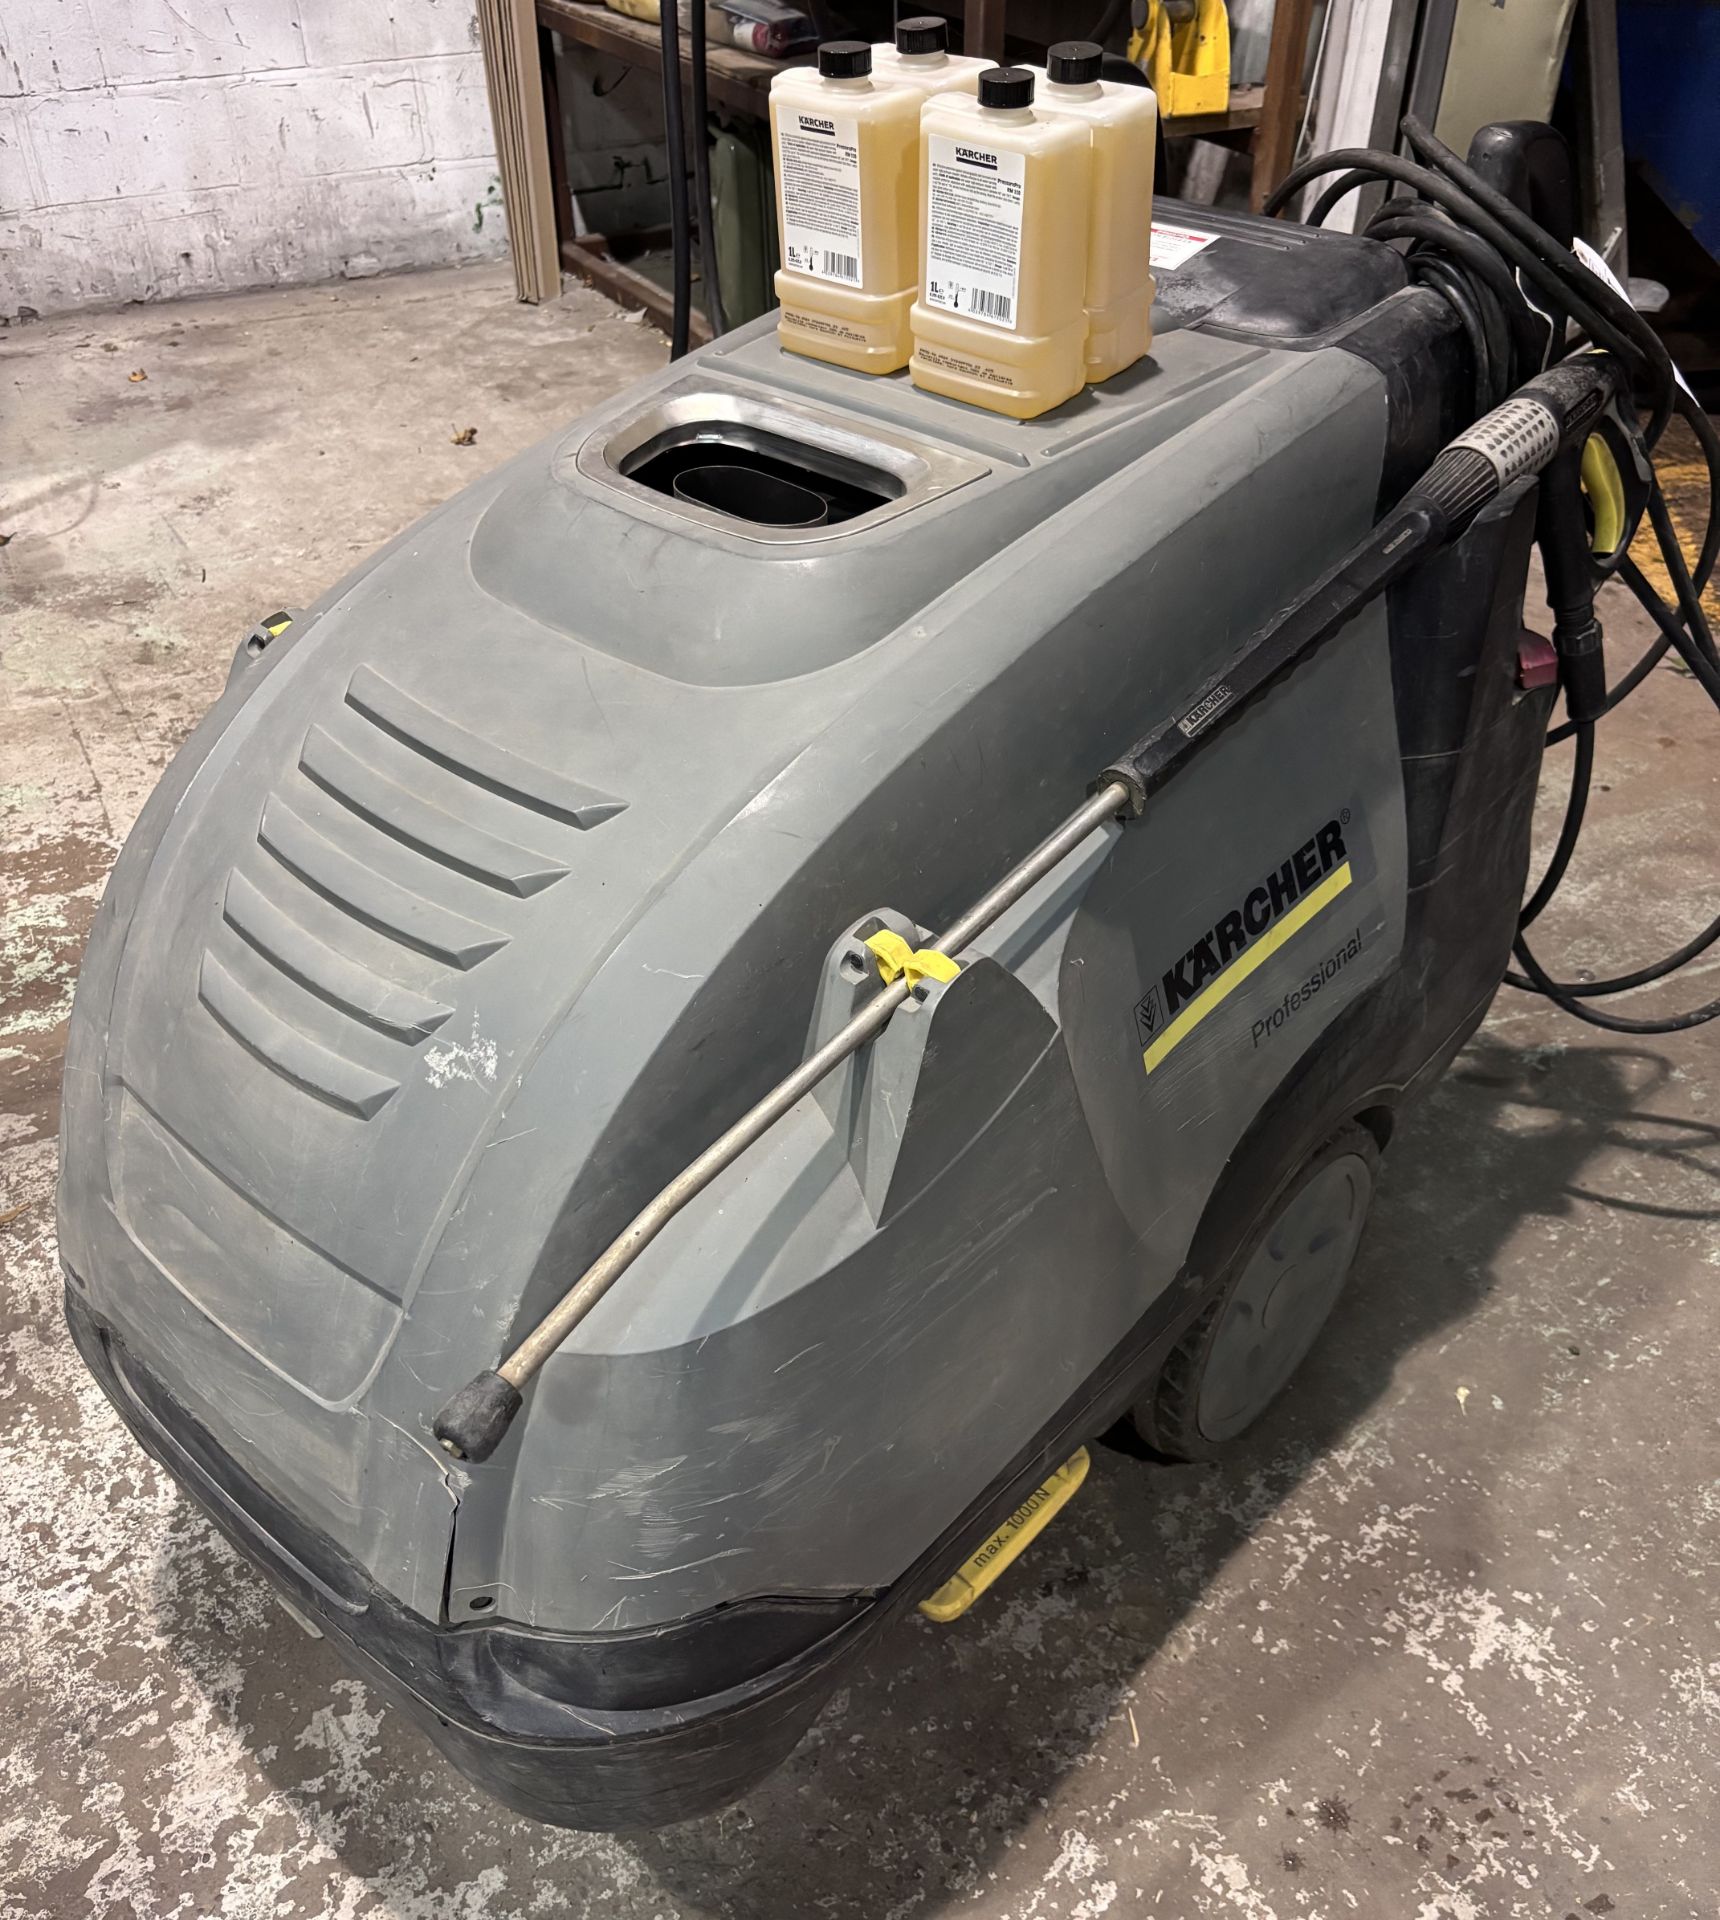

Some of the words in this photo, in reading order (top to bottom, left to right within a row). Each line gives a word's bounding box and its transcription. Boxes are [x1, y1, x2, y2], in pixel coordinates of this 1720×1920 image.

[798, 115, 835, 130] KÄRCHER
[955, 146, 998, 164] KÄRCHER
[930, 281, 939, 293] 1L
[1250, 927, 1363, 1048] Professional
[973, 1533, 1010, 1568] max.
